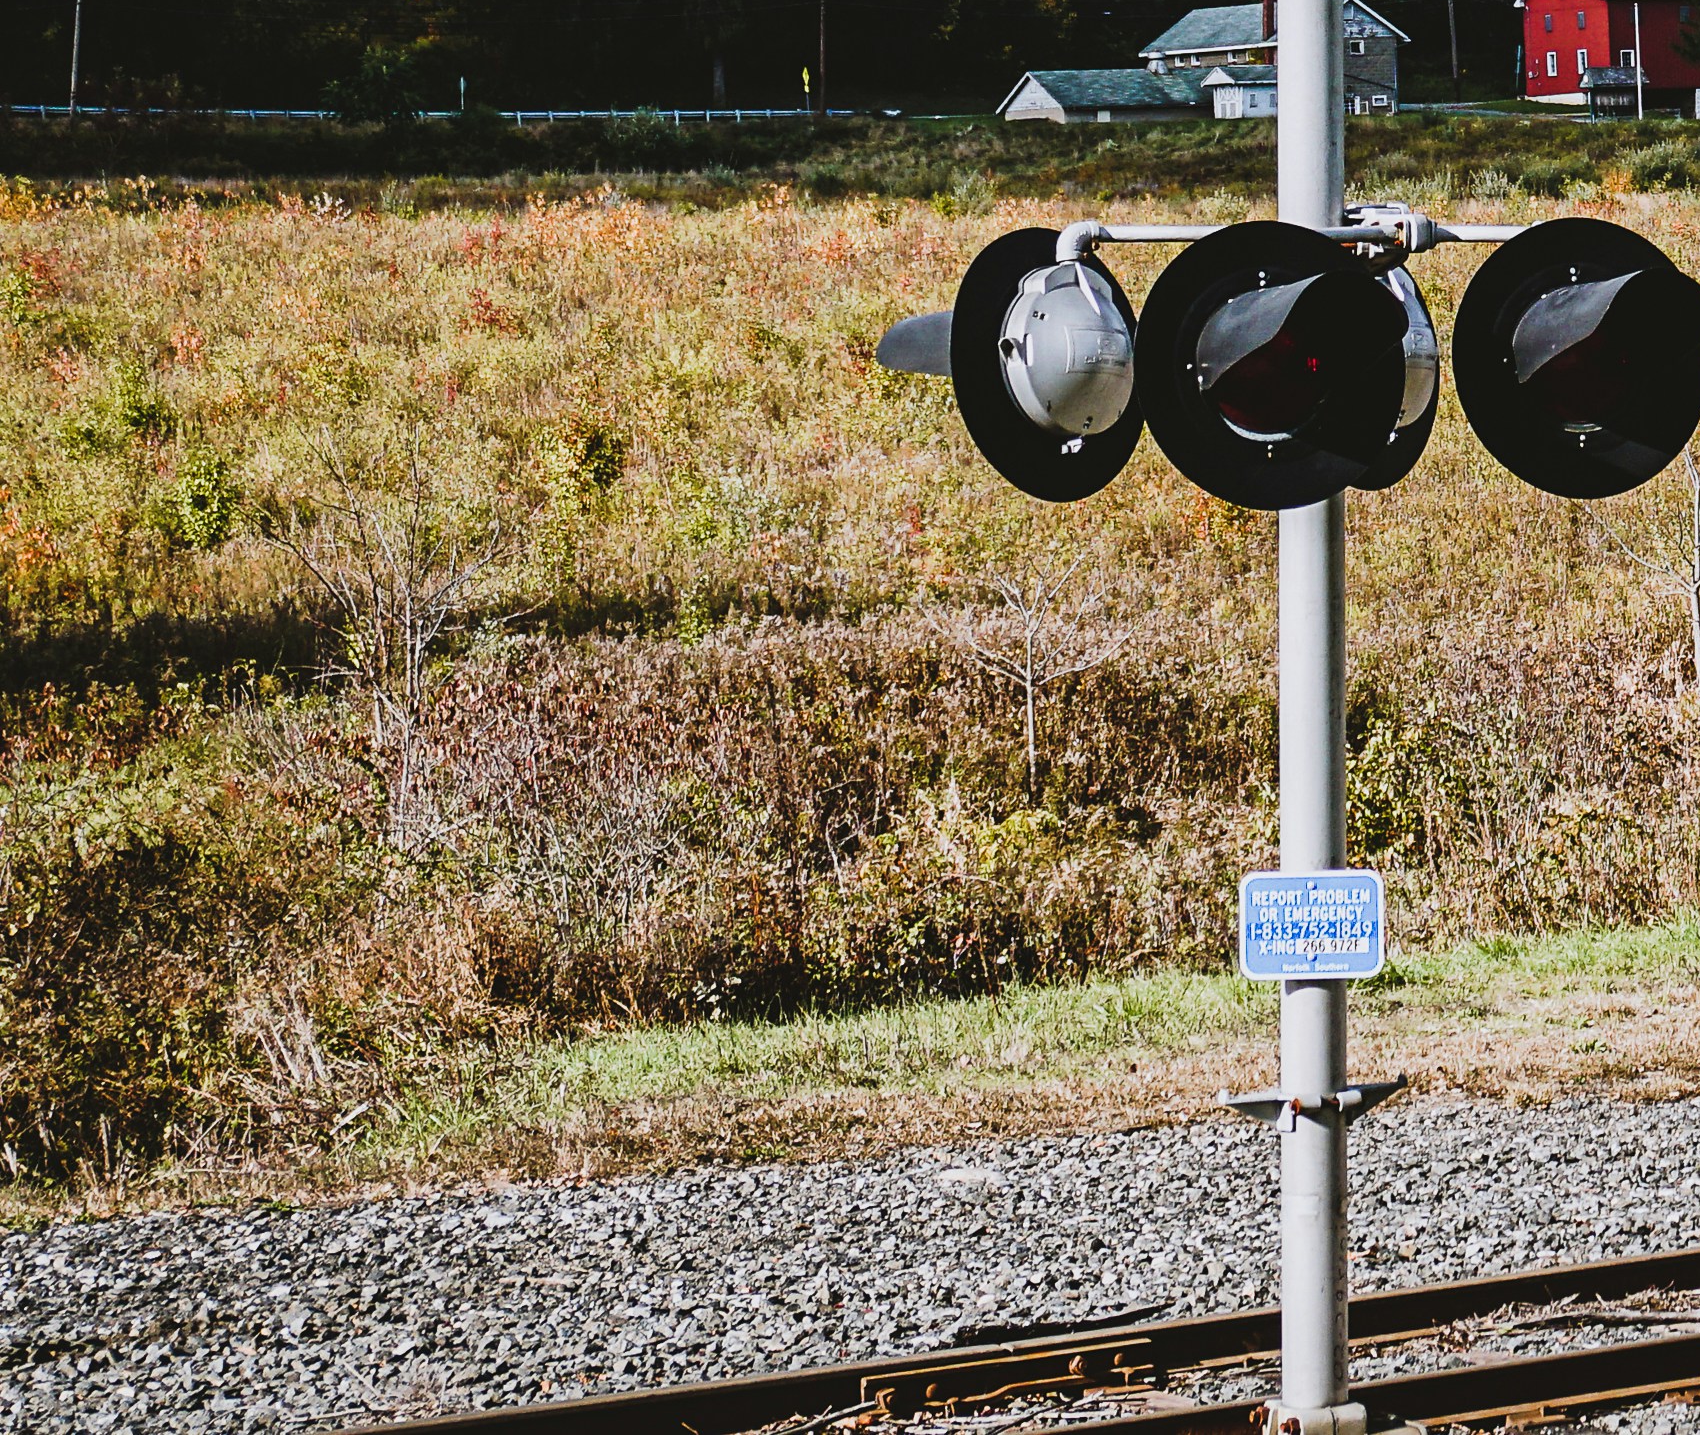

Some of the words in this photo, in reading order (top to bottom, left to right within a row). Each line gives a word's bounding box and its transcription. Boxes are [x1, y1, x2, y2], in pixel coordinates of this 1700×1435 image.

[1252, 890, 1303, 906] REPORT
[1308, 888, 1371, 905] PROBLEM
[1259, 907, 1278, 922] OR
[1284, 905, 1364, 922] EMERGENCY
[1250, 921, 1373, 940] 1-833-752-1849
[1259, 939, 1295, 955] X-ING
[1303, 939, 1326, 953] 266
[1315, 962, 1349, 972] Southern
